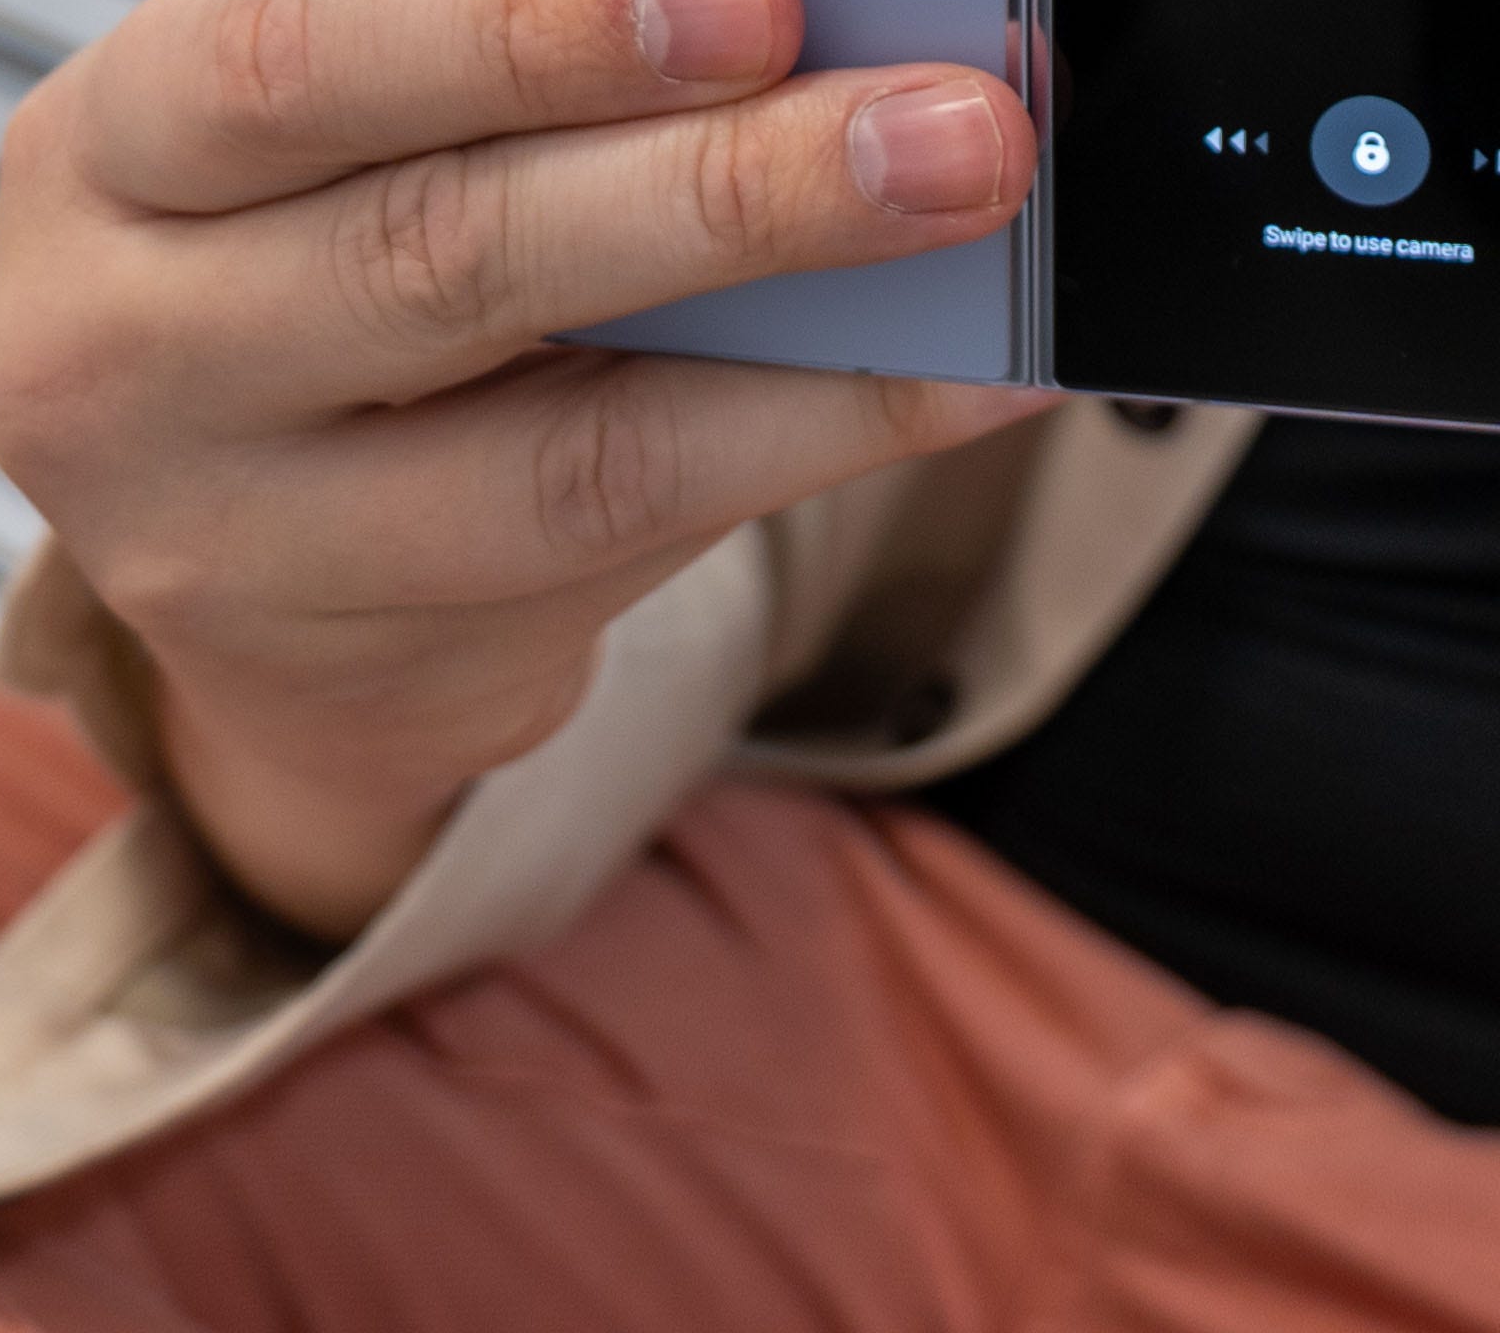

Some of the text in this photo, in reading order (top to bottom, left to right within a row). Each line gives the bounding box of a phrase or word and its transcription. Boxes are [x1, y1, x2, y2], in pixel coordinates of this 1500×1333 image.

[1263, 224, 1474, 263] Swipe to use camera
